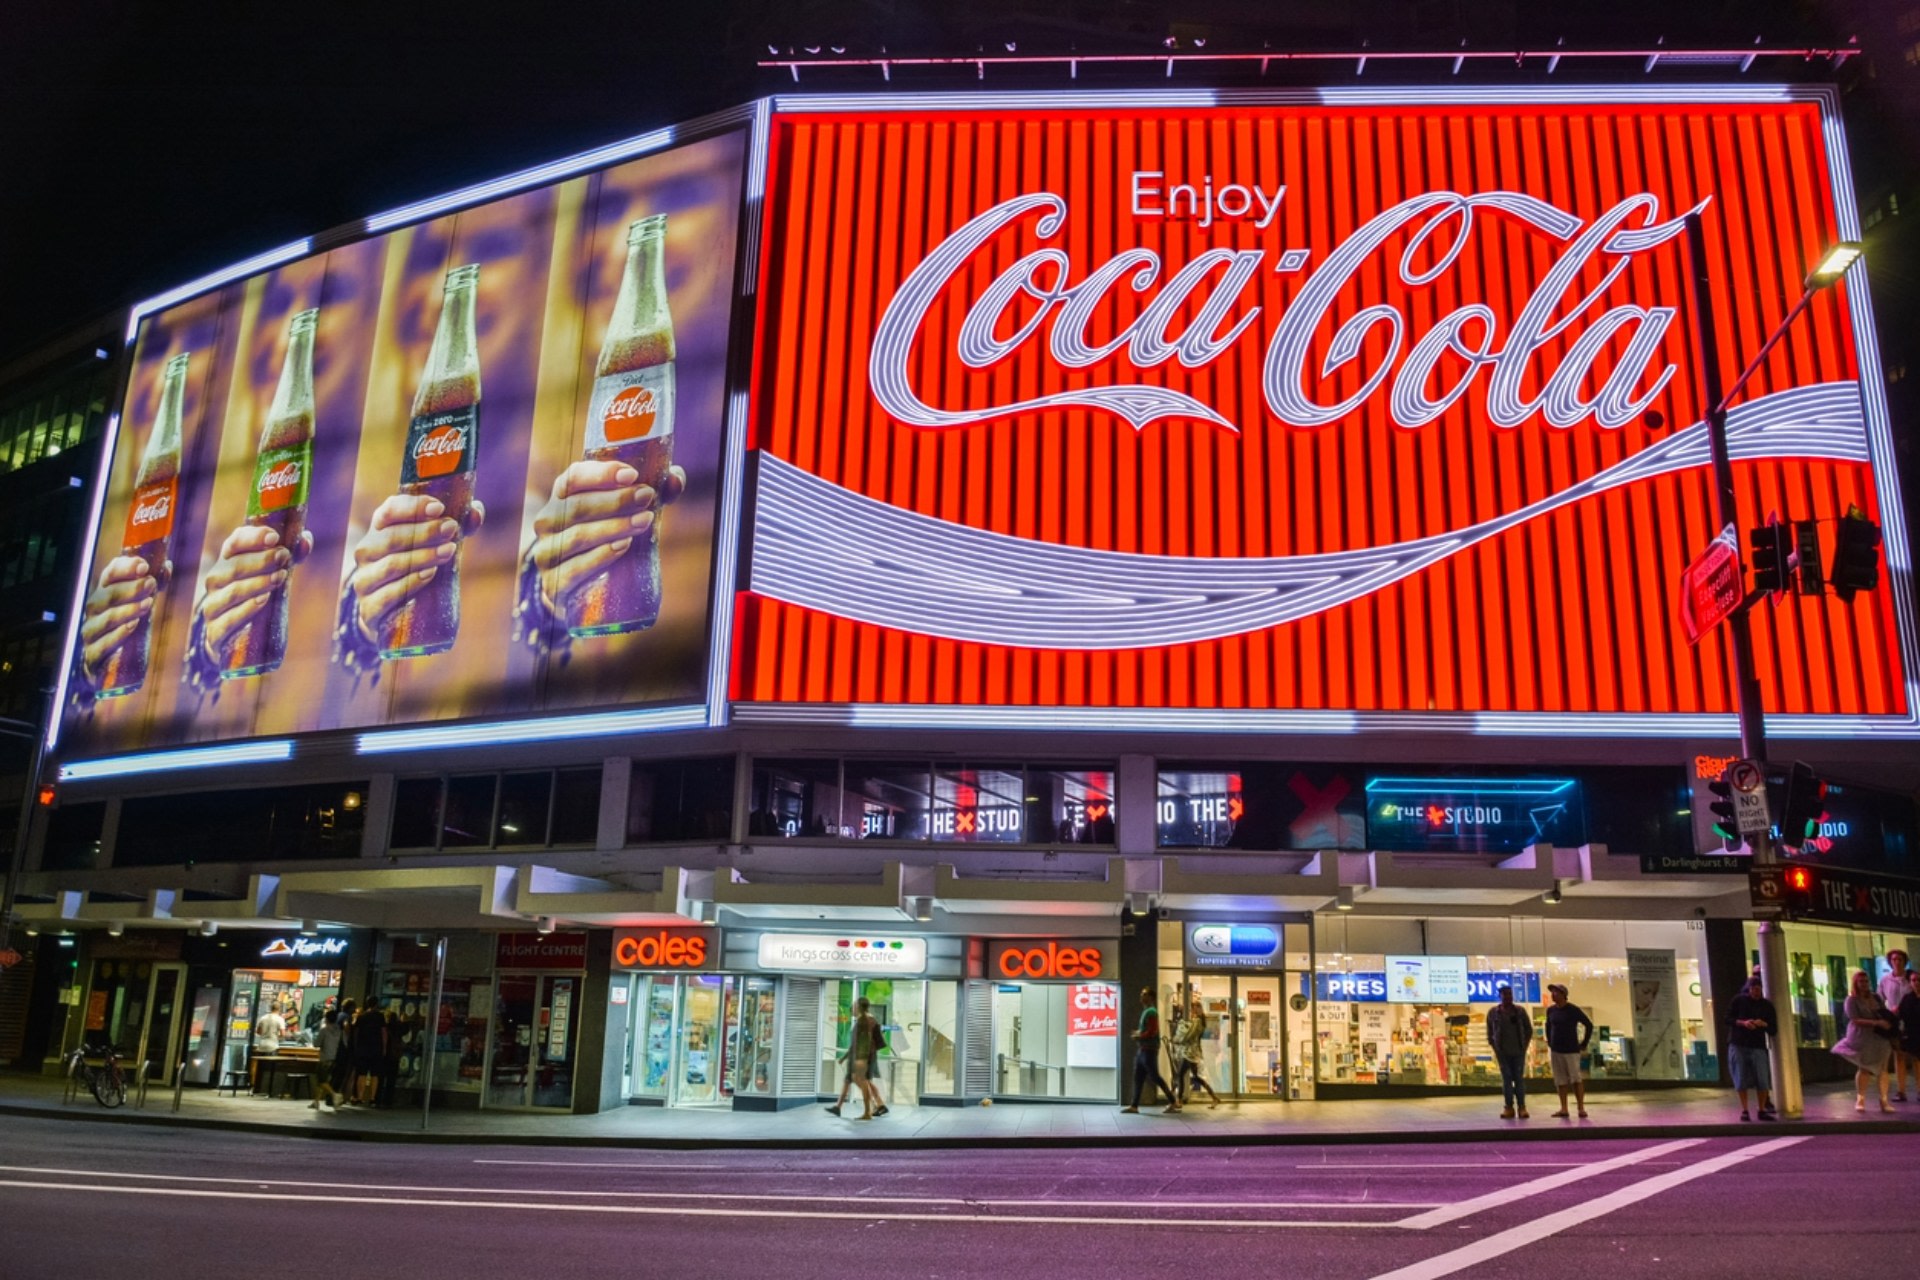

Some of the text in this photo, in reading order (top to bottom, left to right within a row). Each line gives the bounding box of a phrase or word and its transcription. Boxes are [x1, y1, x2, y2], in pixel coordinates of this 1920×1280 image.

[1131, 170, 1287, 228] Enjoy
[600, 387, 662, 422] Coca-Cola
[434, 414, 453, 427] zero
[413, 425, 470, 460] Coca-Cola
[1190, 799, 1226, 821] THE
[1741, 795, 1759, 807] NO
[923, 813, 954, 833] THE
[1445, 806, 1501, 824] STUDIO
[1739, 809, 1764, 821] RIGHT
[1741, 818, 1767, 831] TURN
[1662, 856, 1738, 871] Darlinghurst Rd
[1821, 879, 1853, 911] THE
[501, 944, 585, 956] FLIGHT CENTRE
[615, 930, 706, 967] coles
[782, 946, 817, 964] kings
[819, 949, 852, 962] cross
[853, 950, 898, 963] centre
[998, 941, 1102, 977] coles
[1629, 953, 1669, 965] Fillerina
[1328, 1011, 1346, 1019] OUT
